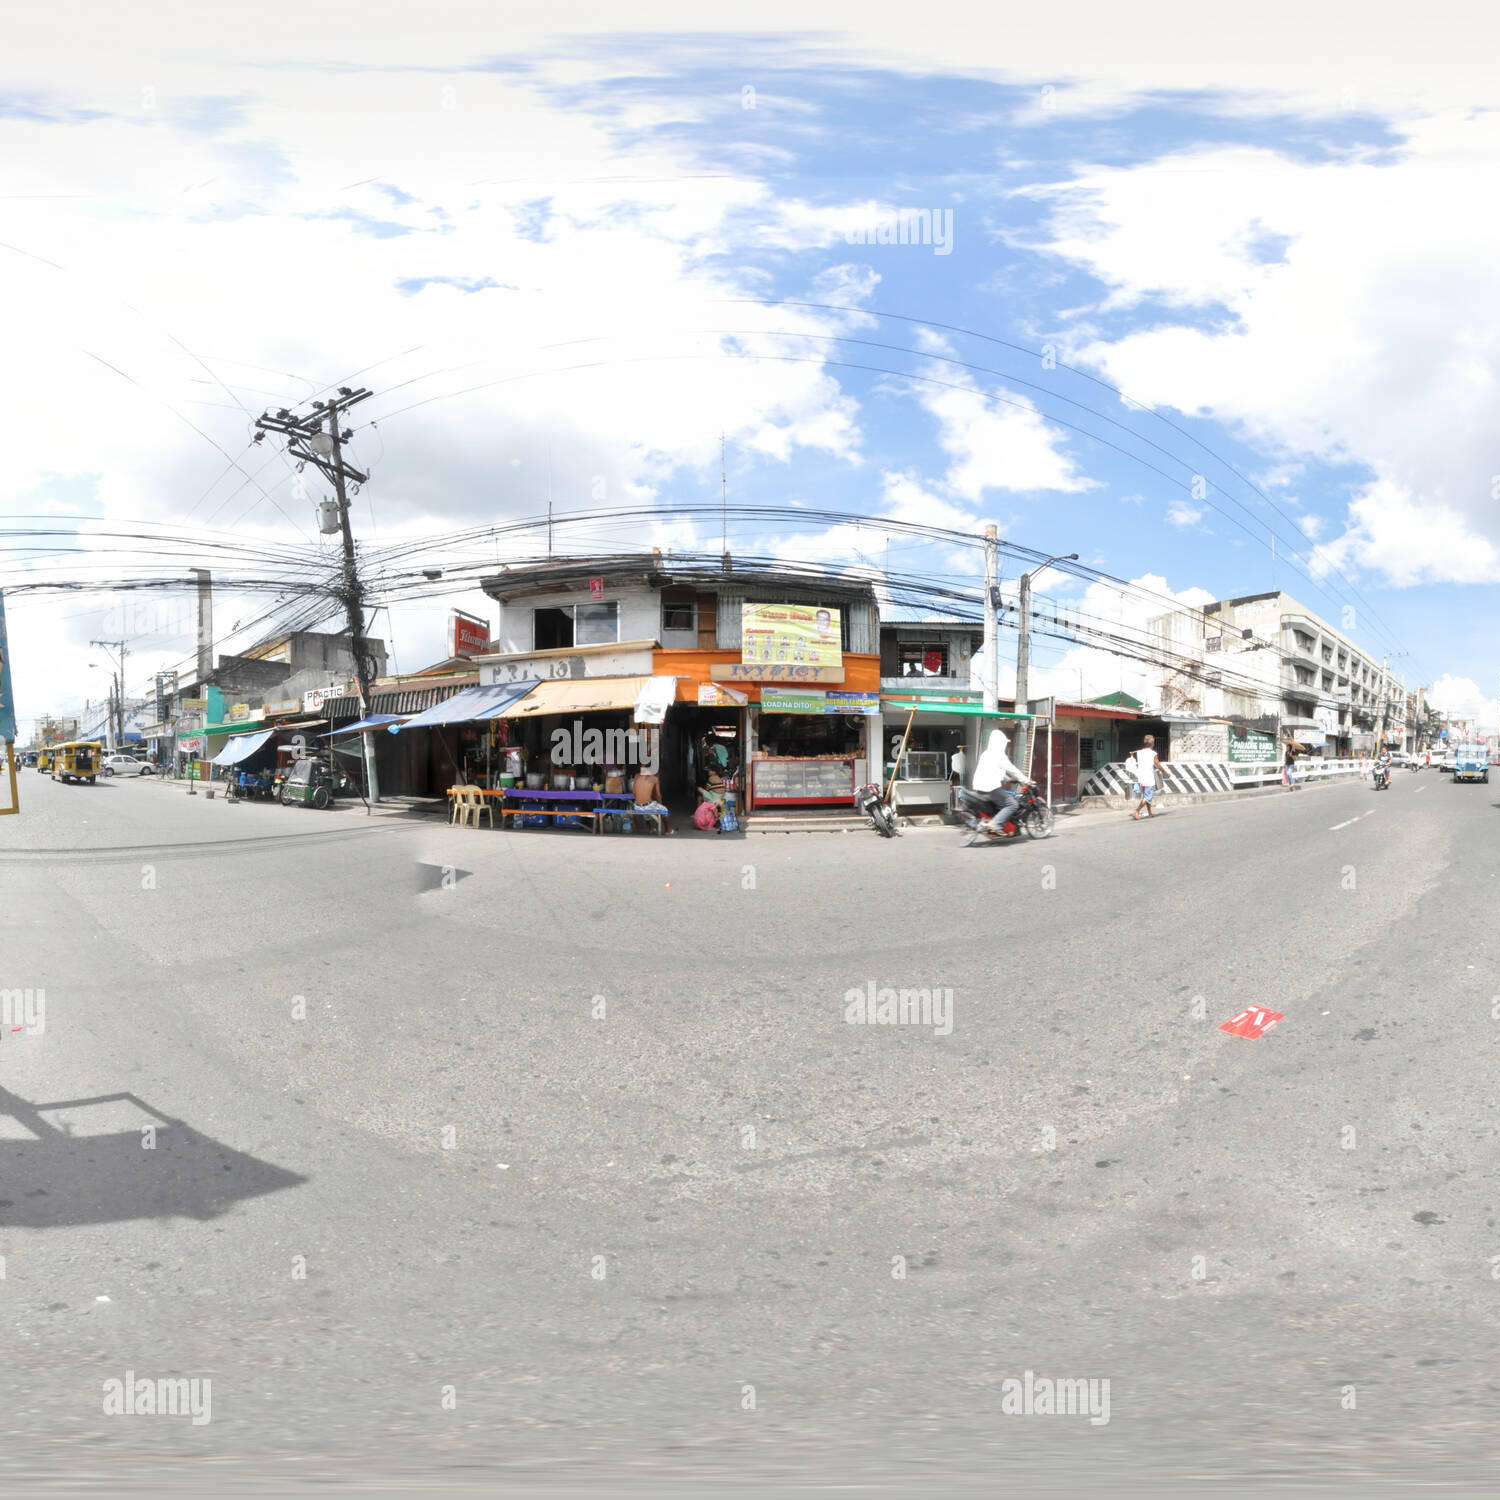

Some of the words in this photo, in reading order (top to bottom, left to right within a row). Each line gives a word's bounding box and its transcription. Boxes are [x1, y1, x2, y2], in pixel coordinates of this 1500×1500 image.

[732, 664, 769, 676] IVY
[763, 701, 782, 709] LOAD
[794, 702, 812, 710] DITO!
